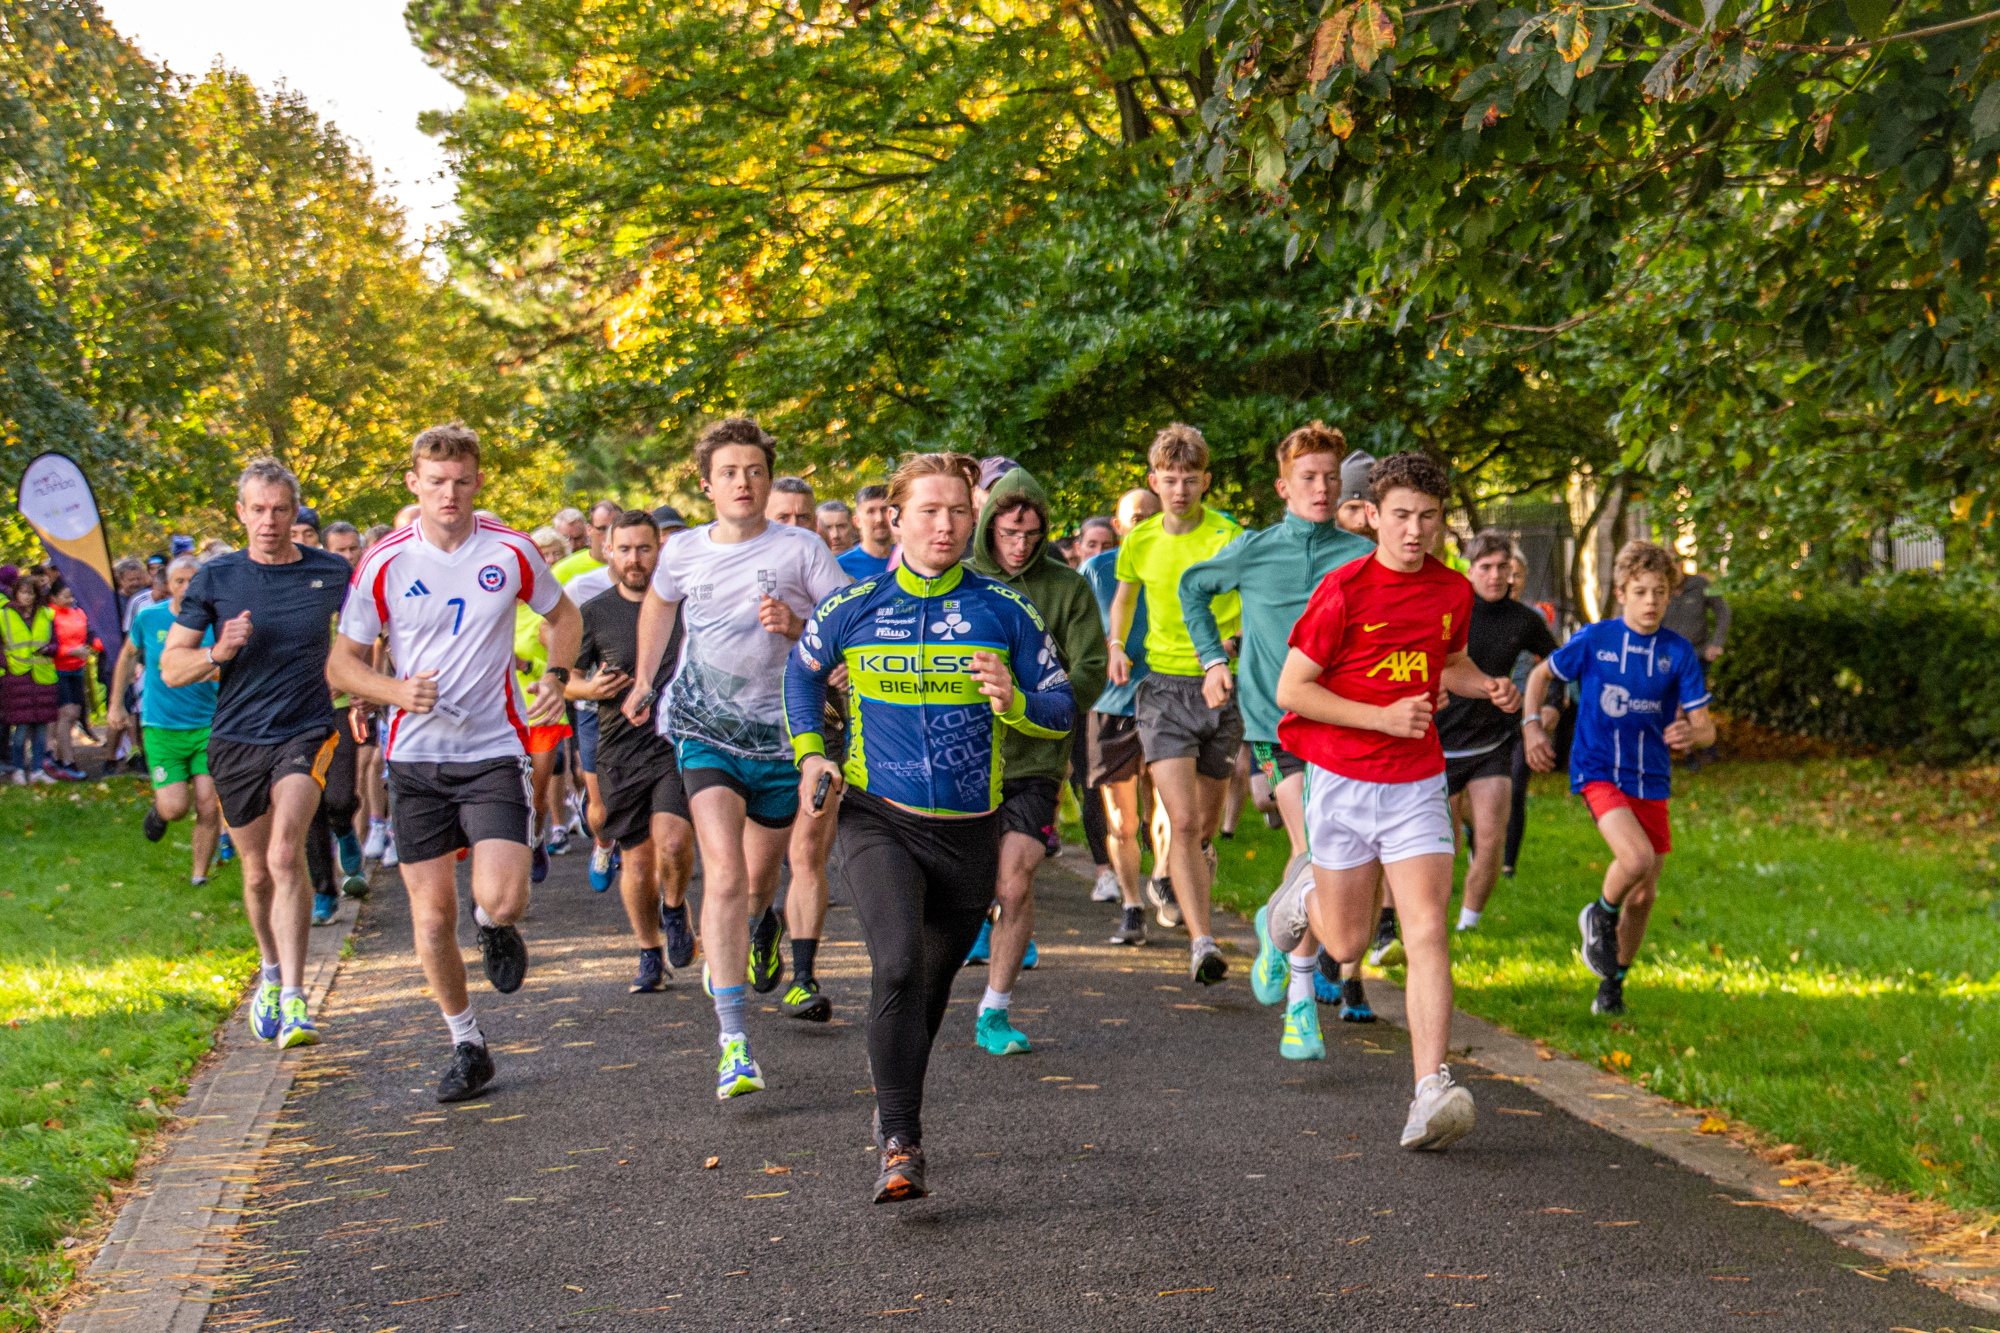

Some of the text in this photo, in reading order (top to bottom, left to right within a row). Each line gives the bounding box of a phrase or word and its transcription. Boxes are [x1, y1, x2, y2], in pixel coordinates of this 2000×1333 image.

[447, 598, 466, 636] 7
[817, 582, 877, 623] KOLSS
[987, 584, 1046, 632] KOLSS
[1366, 651, 1429, 683] AXA
[880, 680, 963, 694] BIEMME
